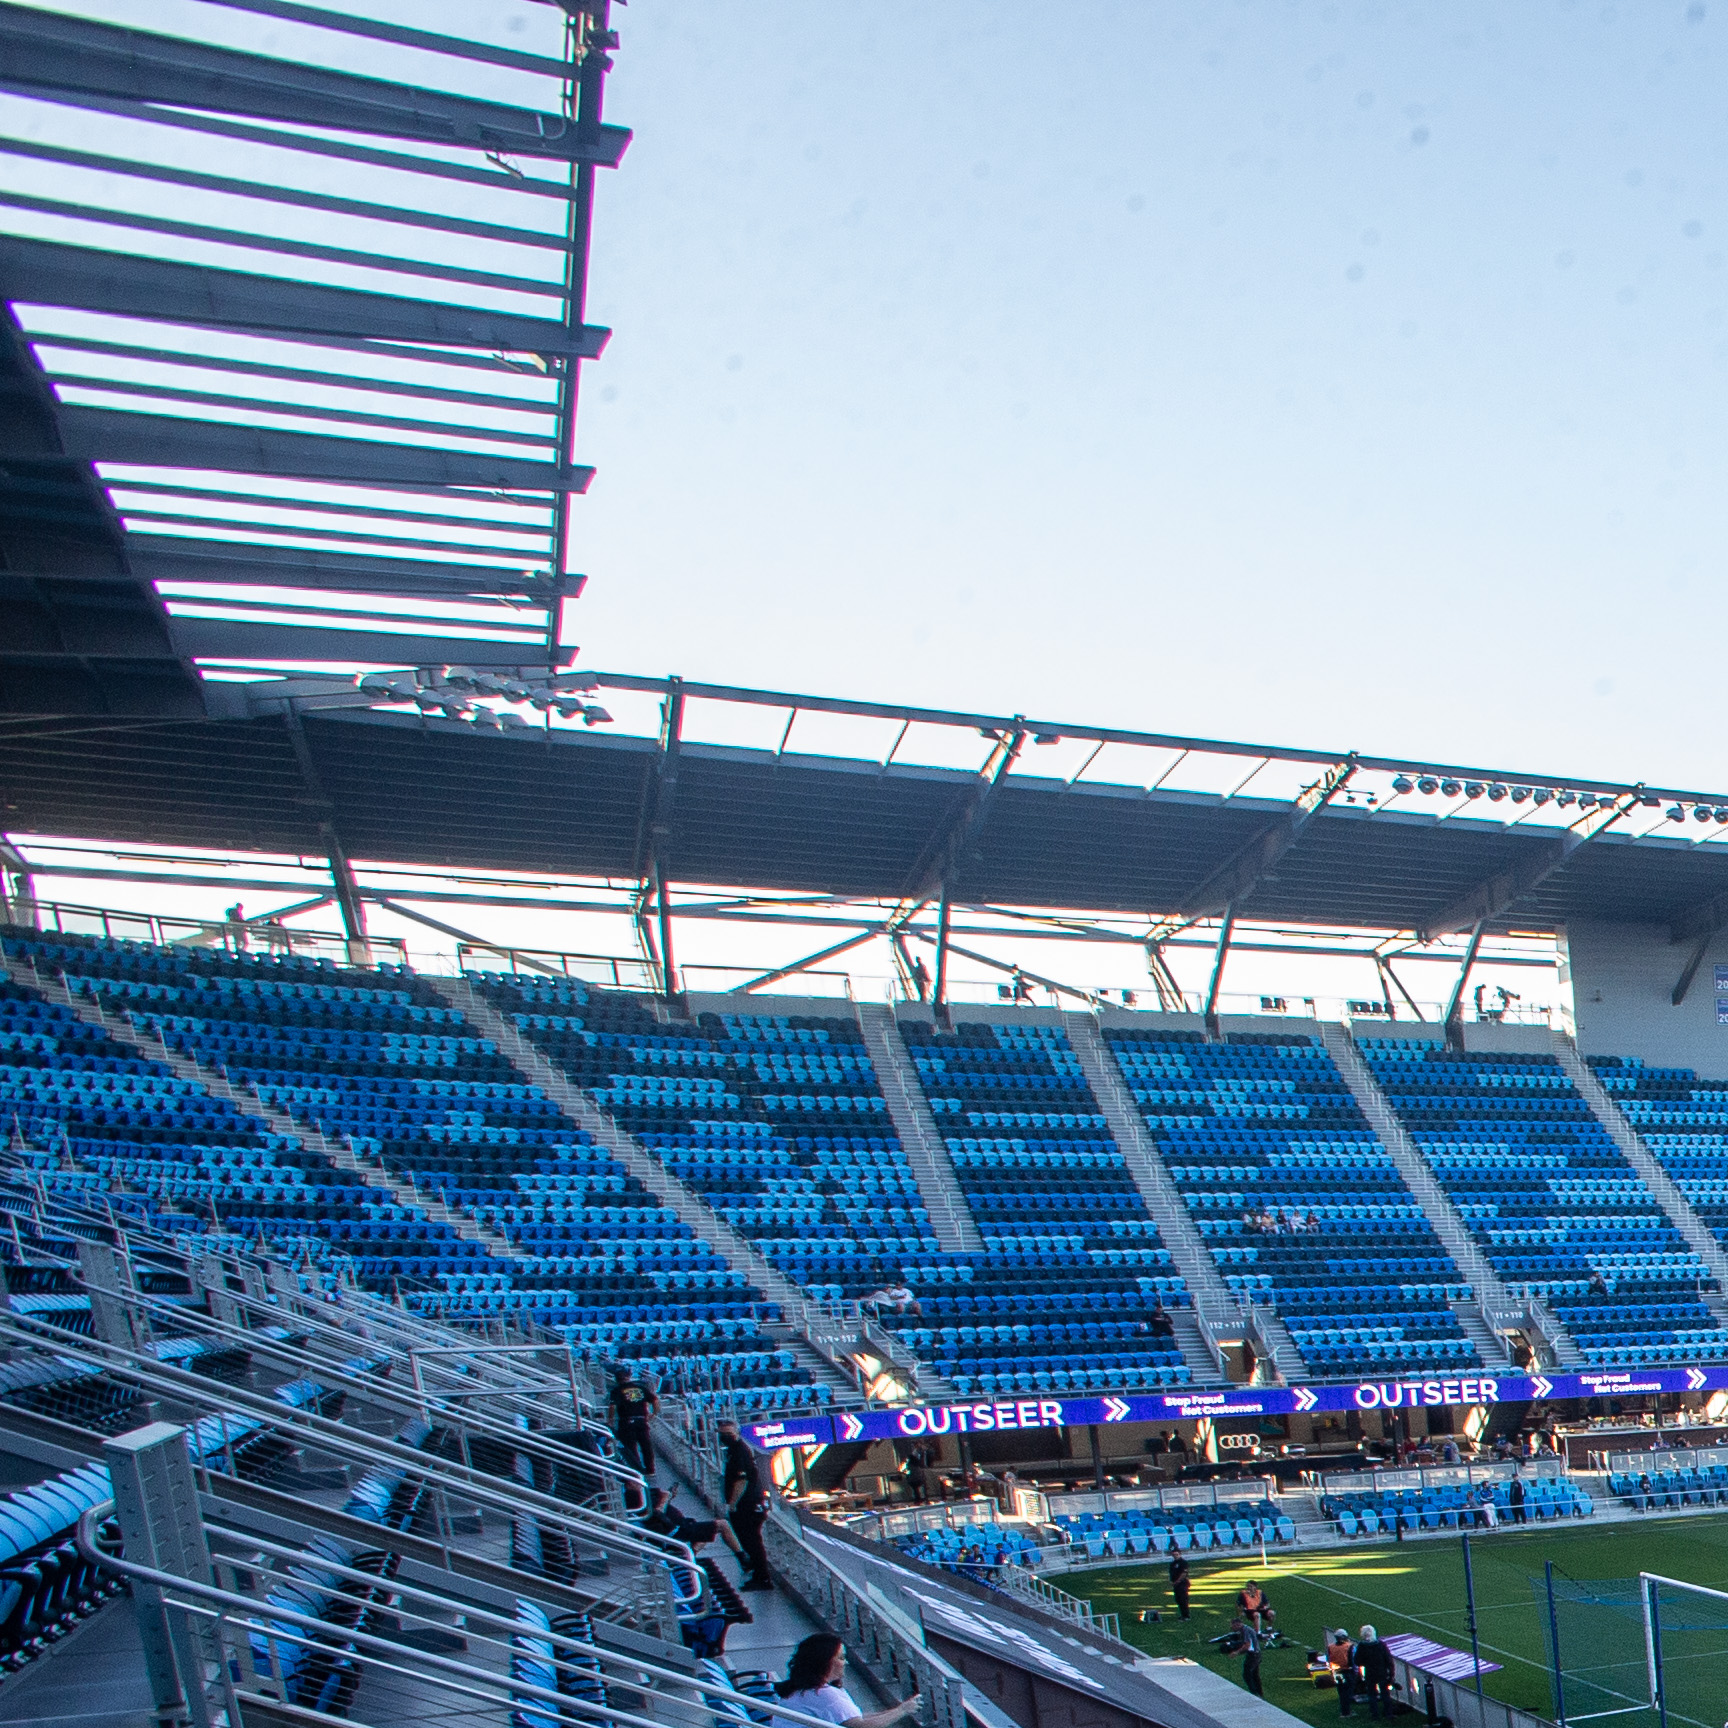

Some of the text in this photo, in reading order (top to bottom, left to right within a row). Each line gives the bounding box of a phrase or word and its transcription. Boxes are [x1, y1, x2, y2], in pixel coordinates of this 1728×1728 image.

[1580, 1373, 1631, 1386] Stop Fraud
[1354, 1379, 1500, 1409] OUTSEER
[1594, 1382, 1662, 1393] Not Customers
[1163, 1394, 1225, 1407] Stop Fraud
[1180, 1404, 1263, 1416] Not Customers
[899, 1401, 1065, 1435] OUTSEER
